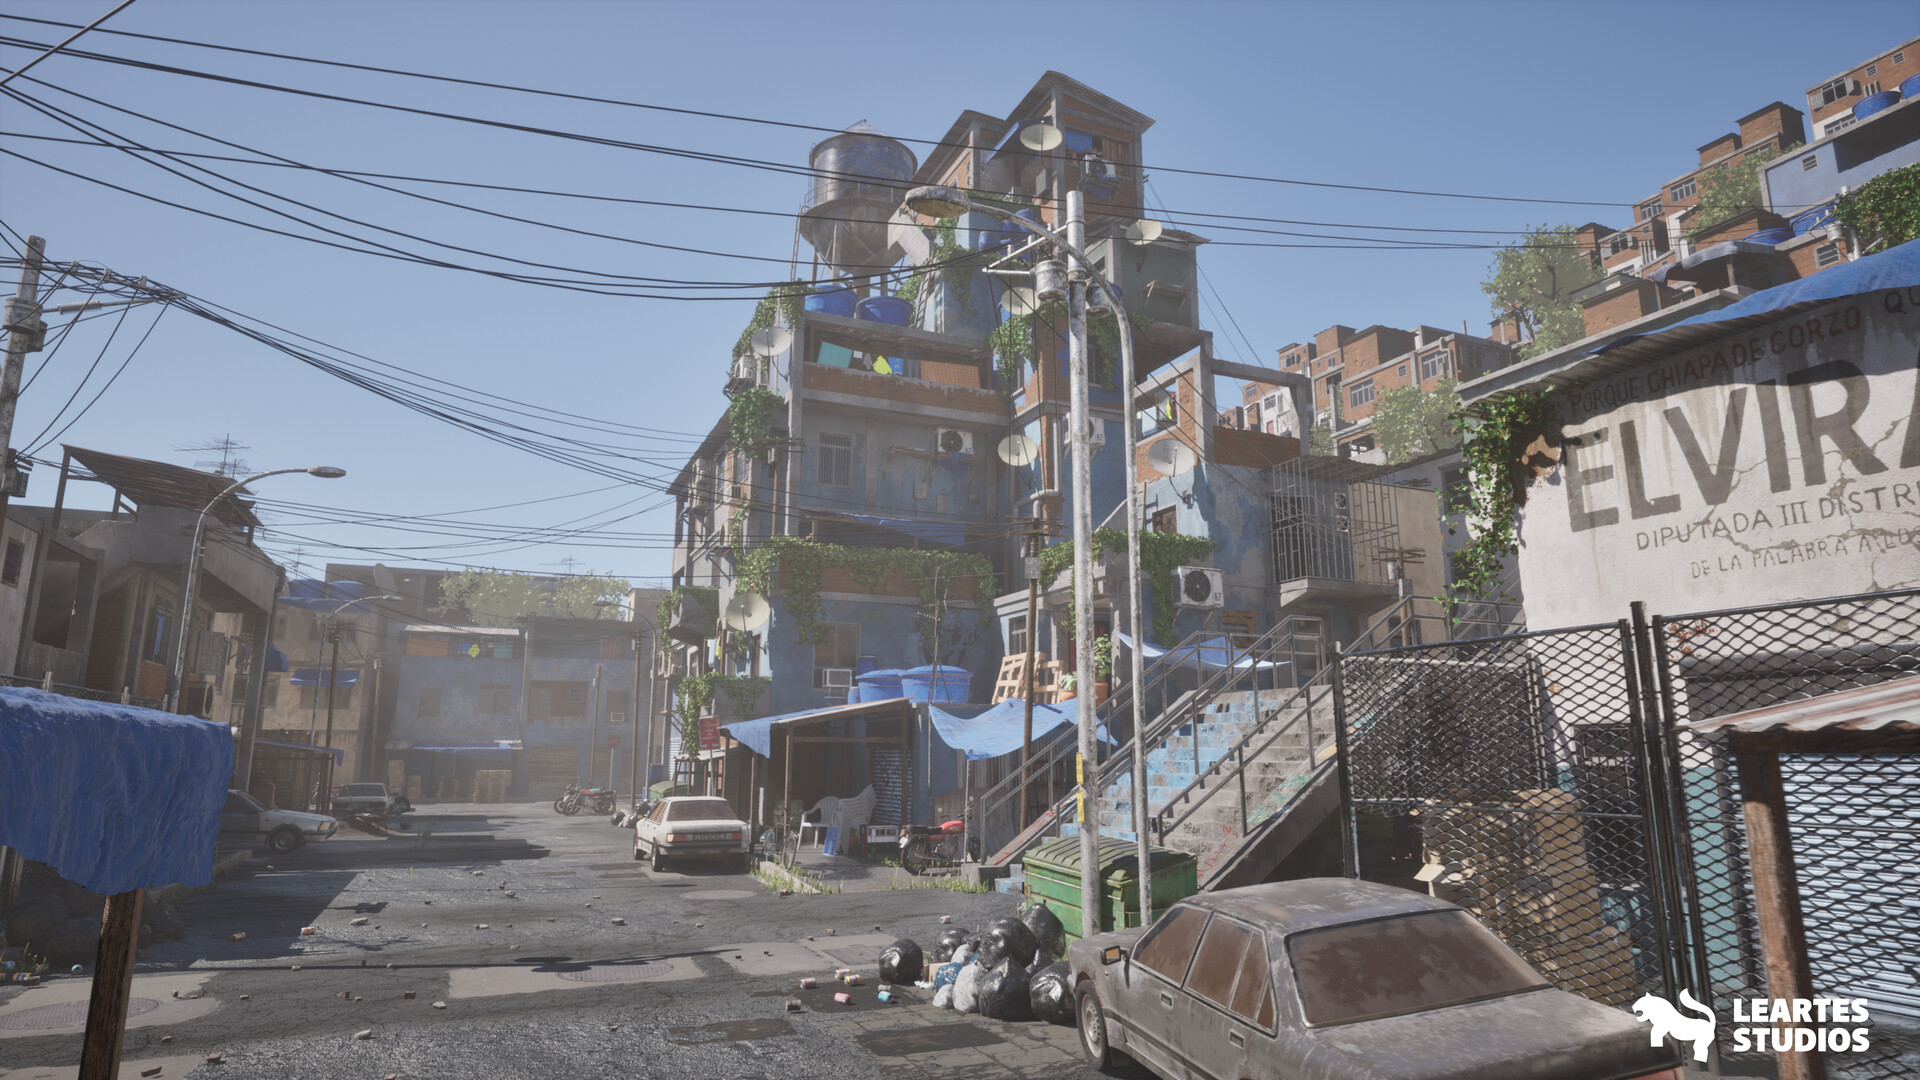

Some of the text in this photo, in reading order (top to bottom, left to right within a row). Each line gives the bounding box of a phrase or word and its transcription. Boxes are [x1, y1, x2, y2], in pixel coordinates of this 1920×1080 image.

[1572, 377, 1639, 416] PORQUE
[1770, 305, 1861, 354] CORZO
[1563, 345, 1920, 533] ELVIR
[1636, 509, 1773, 551] DIPUTADA
[1776, 500, 1812, 528] III
[1691, 560, 1711, 579] DE
[1718, 554, 1743, 572] LA
[1752, 537, 1849, 568] PALABRA
